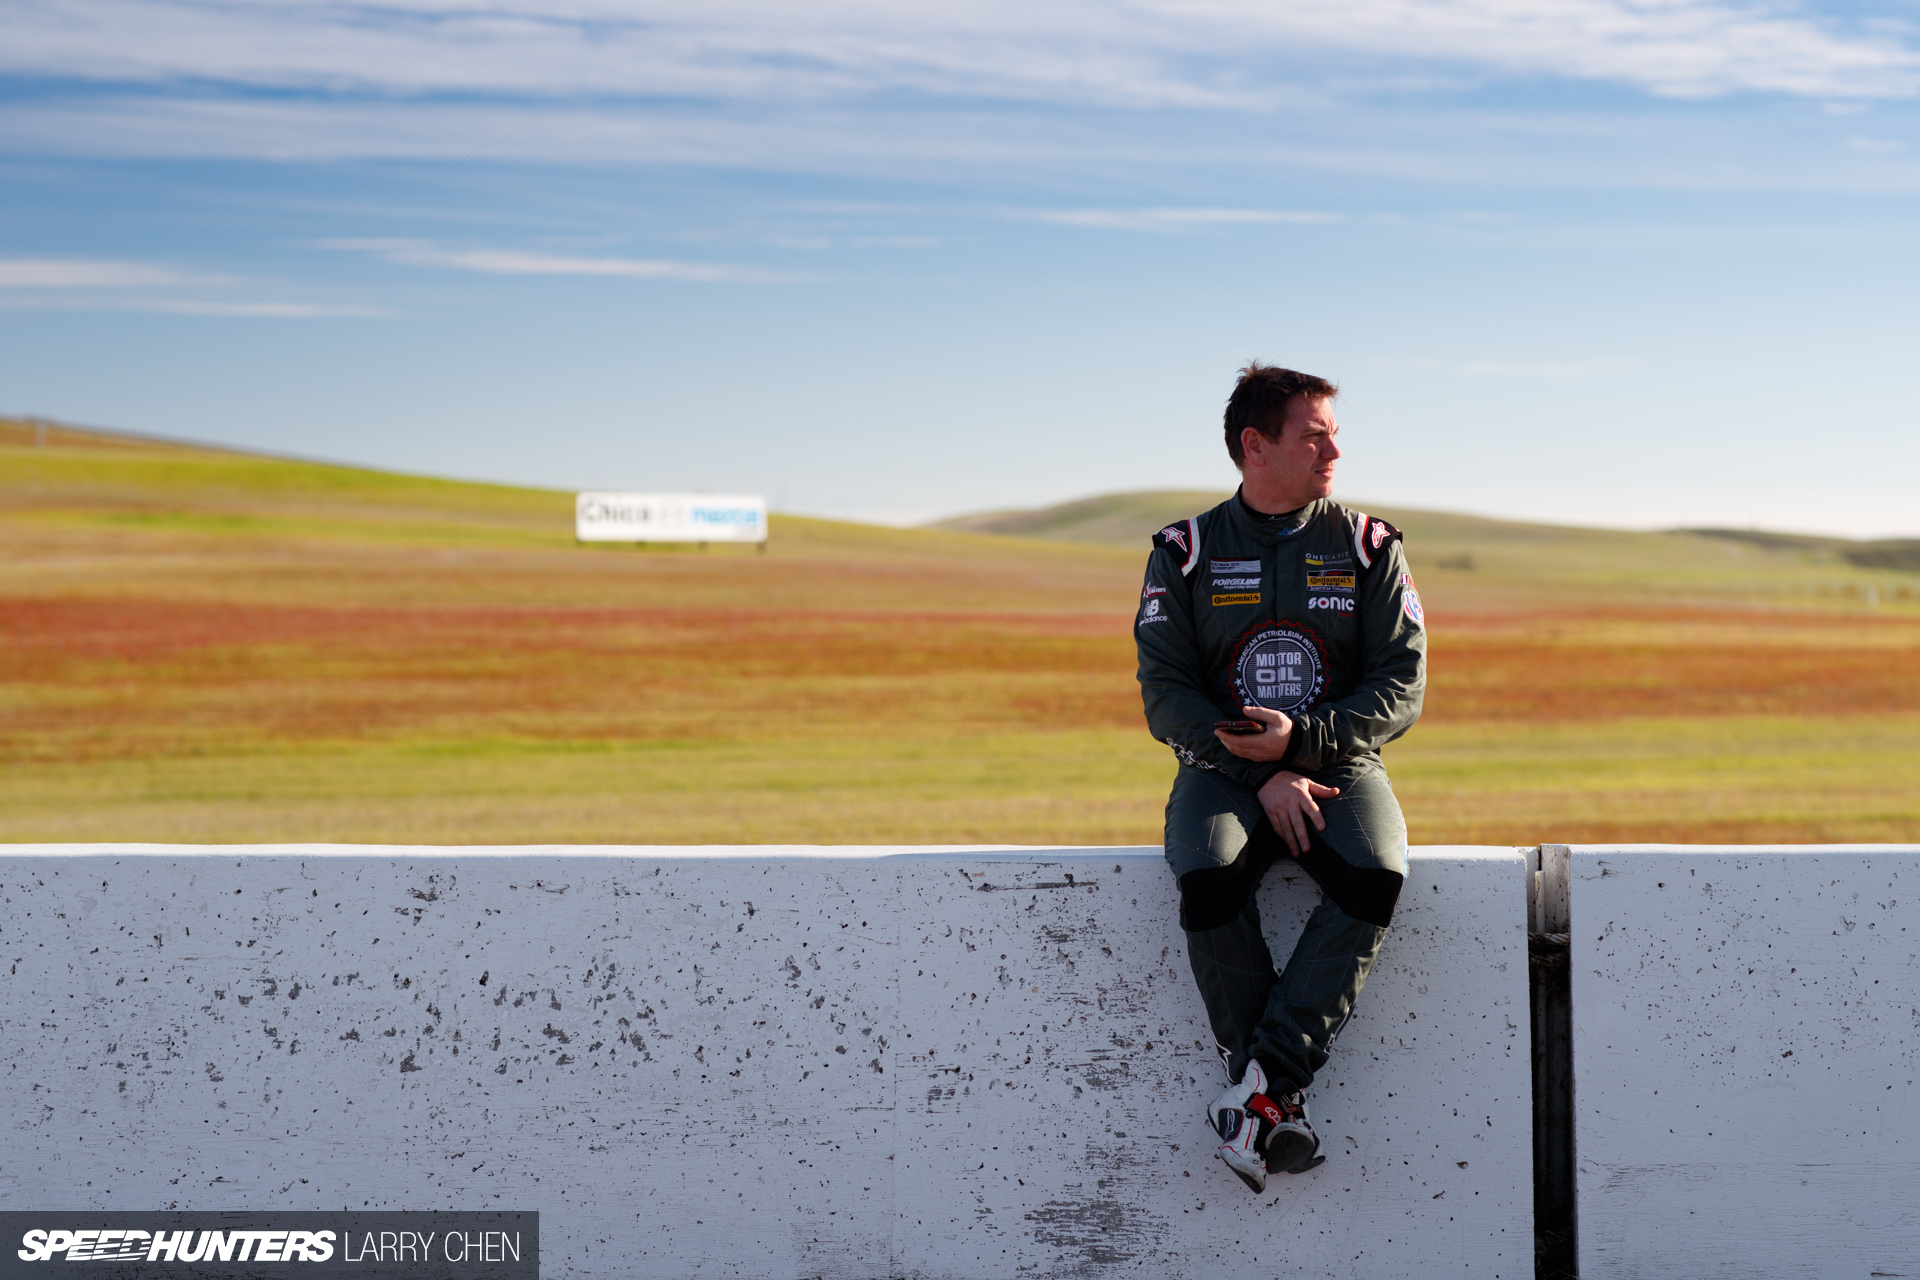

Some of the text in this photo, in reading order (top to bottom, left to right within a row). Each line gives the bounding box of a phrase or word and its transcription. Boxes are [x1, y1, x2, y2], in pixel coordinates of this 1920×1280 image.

[1212, 577, 1262, 587] FORGELINE
[1310, 576, 1346, 584] Continental
[1214, 594, 1253, 605] Continental
[1236, 629, 1323, 672] AMERICAN PETROLEUM INSTITUTE
[1255, 651, 1302, 667] MOTOR
[1255, 666, 1302, 683] OIL
[1257, 683, 1302, 699] MATTERS
